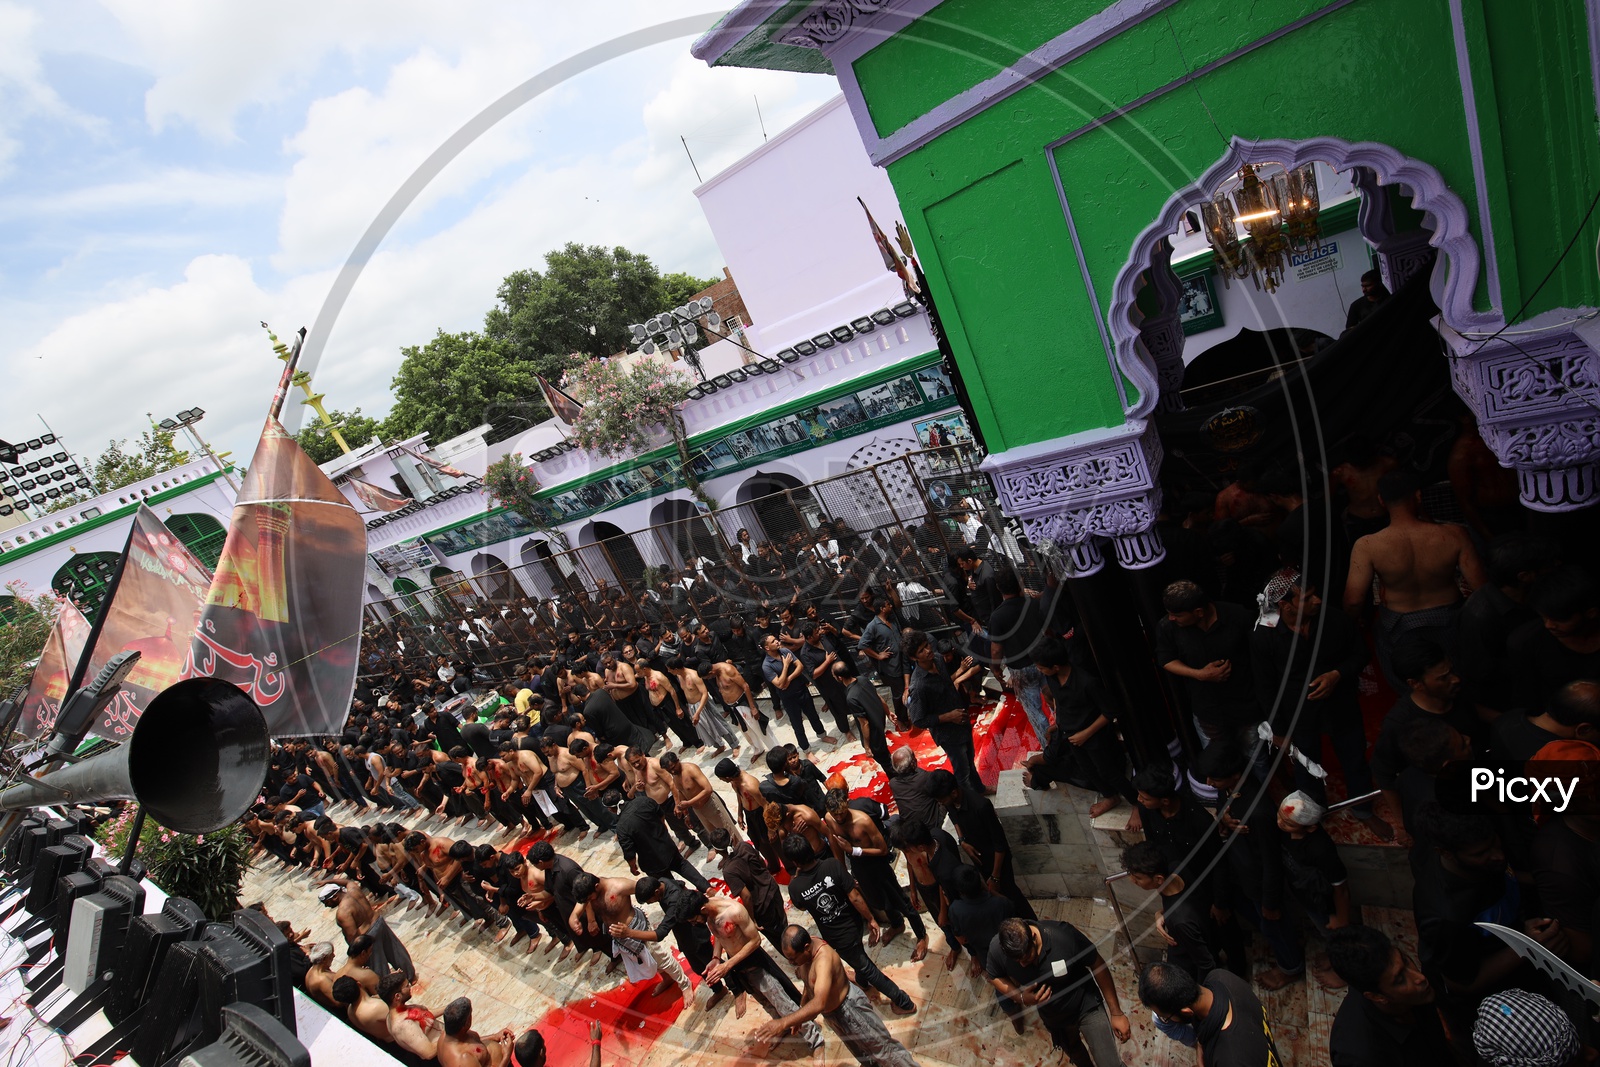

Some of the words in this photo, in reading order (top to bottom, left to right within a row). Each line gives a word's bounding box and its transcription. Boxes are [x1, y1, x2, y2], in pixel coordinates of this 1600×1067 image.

[1295, 244, 1335, 265] NOTICE
[1303, 257, 1329, 267] MANAGEMENT
[1311, 258, 1336, 269] RESPONSIBLE
[1299, 271, 1318, 280] PERSONAL
[1319, 265, 1338, 274] PROPERTY
[801, 882, 823, 898] LUCKY
